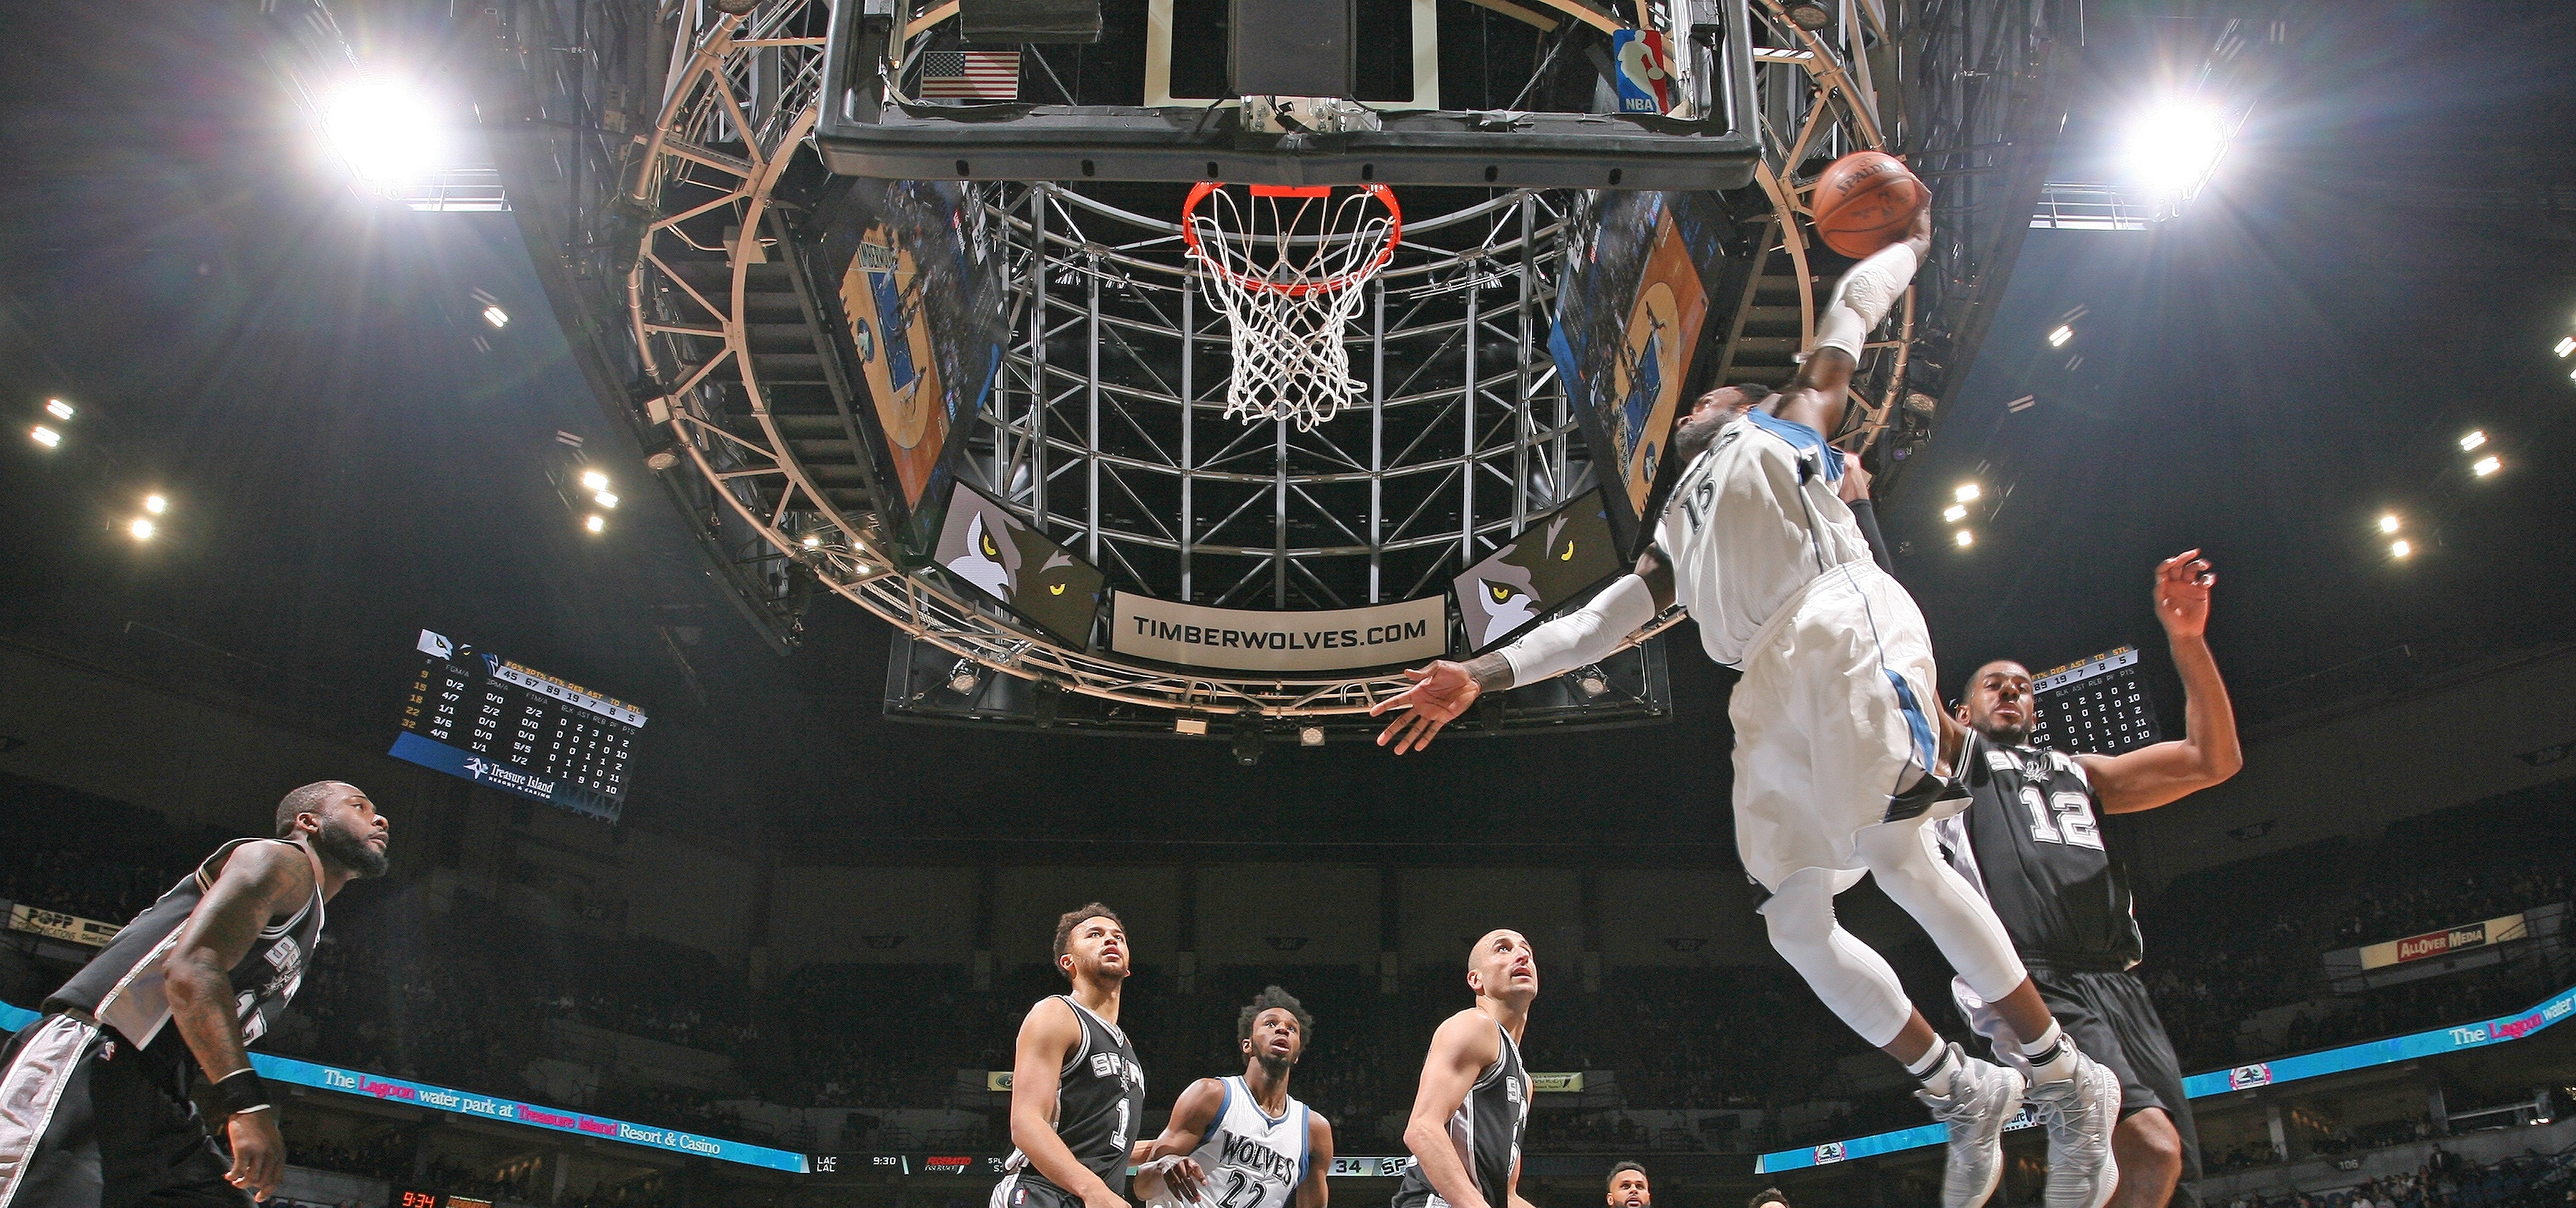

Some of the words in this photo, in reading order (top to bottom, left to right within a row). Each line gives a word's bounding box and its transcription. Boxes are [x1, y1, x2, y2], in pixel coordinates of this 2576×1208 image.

[1625, 97, 1654, 112] NBA
[1681, 468, 1717, 535] 15
[1133, 615, 1427, 651] TIMBERWOLVES.COM
[504, 671, 518, 681] 45
[525, 678, 540, 688] 67
[567, 693, 580, 703] 19
[2054, 675, 2067, 685] 19
[2077, 669, 2084, 678] 7
[2119, 656, 2127, 664] 5
[446, 679, 464, 691] 0/2
[486, 693, 504, 704] 0/0
[525, 706, 543, 718] 2/2
[577, 724, 584, 732] 2
[587, 690, 603, 700] AST
[2062, 702, 2069, 711] 0
[2079, 696, 2087, 705] 2
[2095, 691, 2102, 700] 3
[2111, 687, 2119, 696] 0
[2127, 681, 2137, 690] 2
[2065, 714, 2072, 723] 0
[2082, 708, 2089, 717] 0
[2098, 703, 2107, 712] 2
[2114, 699, 2122, 708] 0
[2127, 693, 2141, 703] 10
[439, 704, 455, 715] 1/1
[478, 716, 497, 729] 0/0
[517, 730, 535, 741] 0/0
[615, 762, 623, 771] 2
[441, 691, 460, 702] 4/7
[482, 705, 501, 716] 2/2
[521, 718, 539, 729] 0/0
[616, 751, 628, 759] 10
[2033, 734, 2051, 744] 0/0
[2068, 726, 2076, 734] 0
[2084, 721, 2092, 729] 0
[2117, 711, 2125, 720] 1
[2134, 706, 2142, 715] 2
[2071, 738, 2079, 746] 0
[2105, 729, 2112, 737] 1
[2120, 723, 2128, 731] 0
[2135, 719, 2147, 728] 11
[2091, 745, 2098, 754] 1
[2107, 740, 2116, 749] 9
[2123, 736, 2131, 744] 0
[2137, 730, 2150, 740] 10
[401, 719, 416, 729] 32
[430, 729, 449, 740] 4/9
[472, 741, 487, 752] 1/1
[512, 754, 528, 766] 1/2
[578, 776, 585, 784] 9
[605, 785, 618, 794] 10
[405, 706, 420, 716] 22
[433, 716, 453, 728] 3/6
[474, 729, 493, 741] 0/0
[513, 741, 532, 754] 5/5
[610, 774, 620, 783] 11
[490, 763, 526, 784] Treasure
[527, 775, 555, 794] Island
[2019, 786, 2105, 852] 12
[2449, 1028, 2486, 1046] The
[2487, 1013, 2544, 1038] Lagoon
[2542, 998, 2573, 1021] water
[323, 1068, 356, 1089] The
[358, 1075, 416, 1099] Lagoon
[419, 1089, 460, 1108] water
[462, 1096, 496, 1114] park
[498, 1104, 514, 1118] at
[517, 1104, 575, 1129] Treasure
[577, 1116, 618, 1136] Island
[619, 1123, 662, 1145] Resort
[664, 1131, 676, 1146] &
[678, 1134, 721, 1155] Casino
[1110, 1097, 1130, 1152] 1
[873, 1156, 897, 1165] 9:30
[1219, 1129, 1296, 1187] WOLVES
[1336, 1159, 1362, 1173] 34
[402, 1191, 436, 1208] 9:34
[1217, 1169, 1267, 1208] 22
